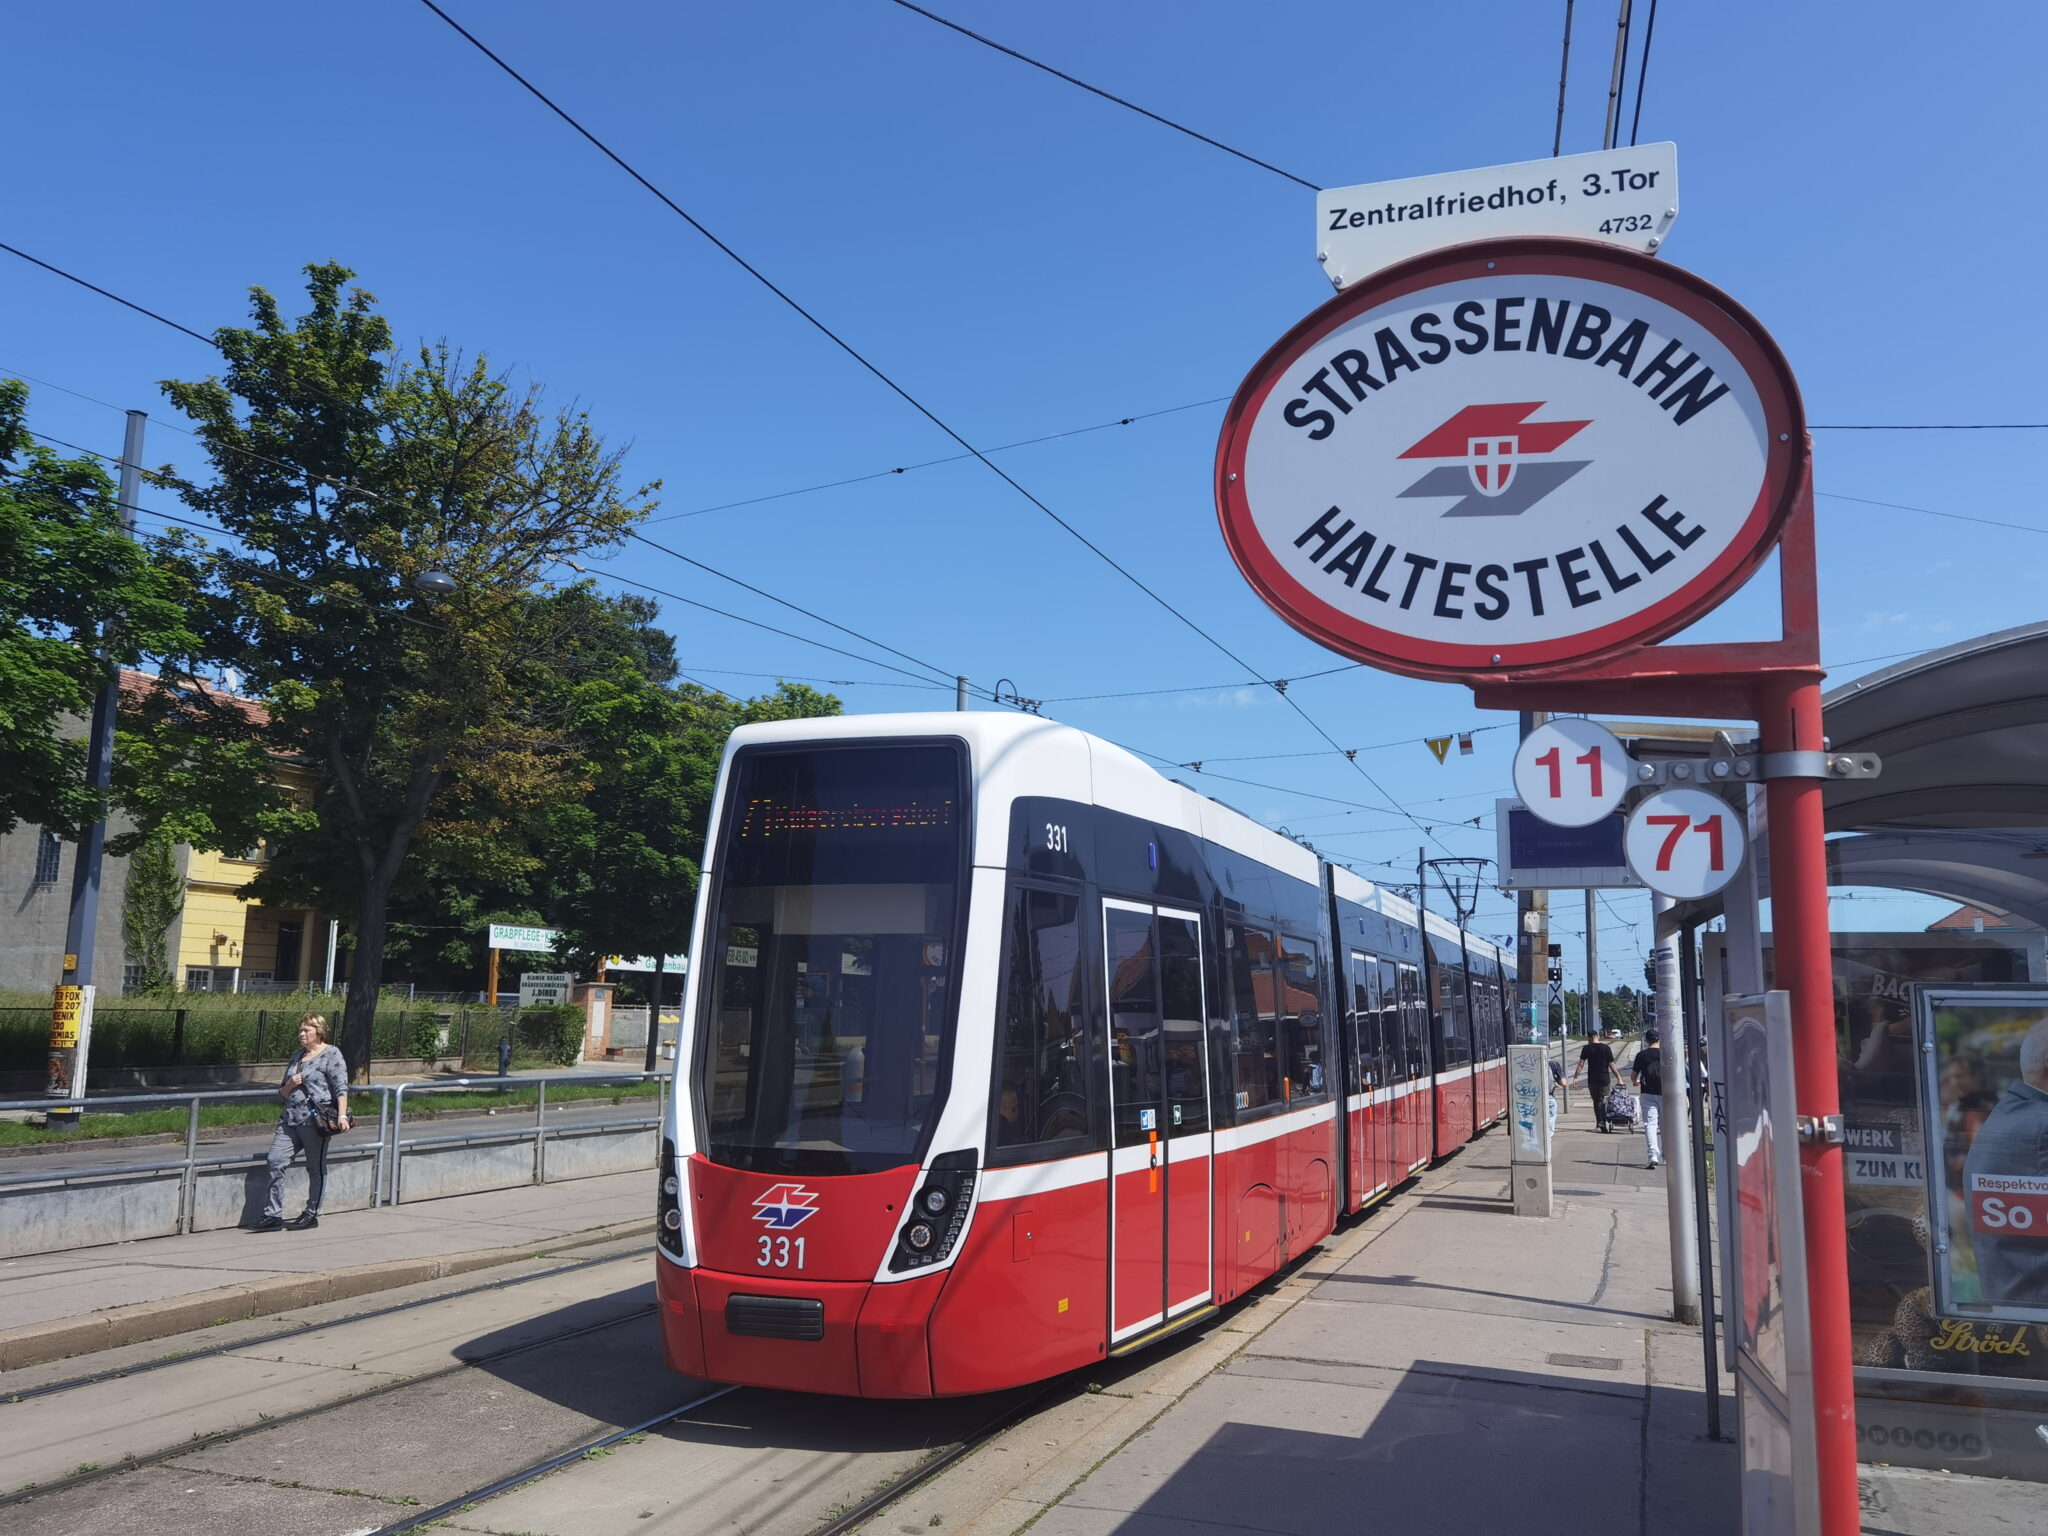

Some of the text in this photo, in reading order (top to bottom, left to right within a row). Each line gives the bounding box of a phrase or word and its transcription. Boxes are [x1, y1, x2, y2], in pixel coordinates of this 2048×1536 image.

[1329, 168, 1660, 231] Zentralfriedhof, 3.Tor
[1599, 214, 1653, 235] 4732
[1283, 296, 1730, 441] STRASSENBAHN
[1293, 494, 1707, 621] HALTESTELLE
[1535, 745, 1604, 798] 11
[1046, 823, 1068, 853] 331
[1646, 814, 1724, 872] 71
[646, 959, 686, 970] Gaenbau
[65, 991, 80, 1001] FOX
[65, 1002, 80, 1010] 207
[1855, 1160, 1897, 1179] ZUM
[1981, 1197, 2033, 1230] So
[757, 1235, 805, 1270] 331
[1930, 1319, 2030, 1356] Ströck
